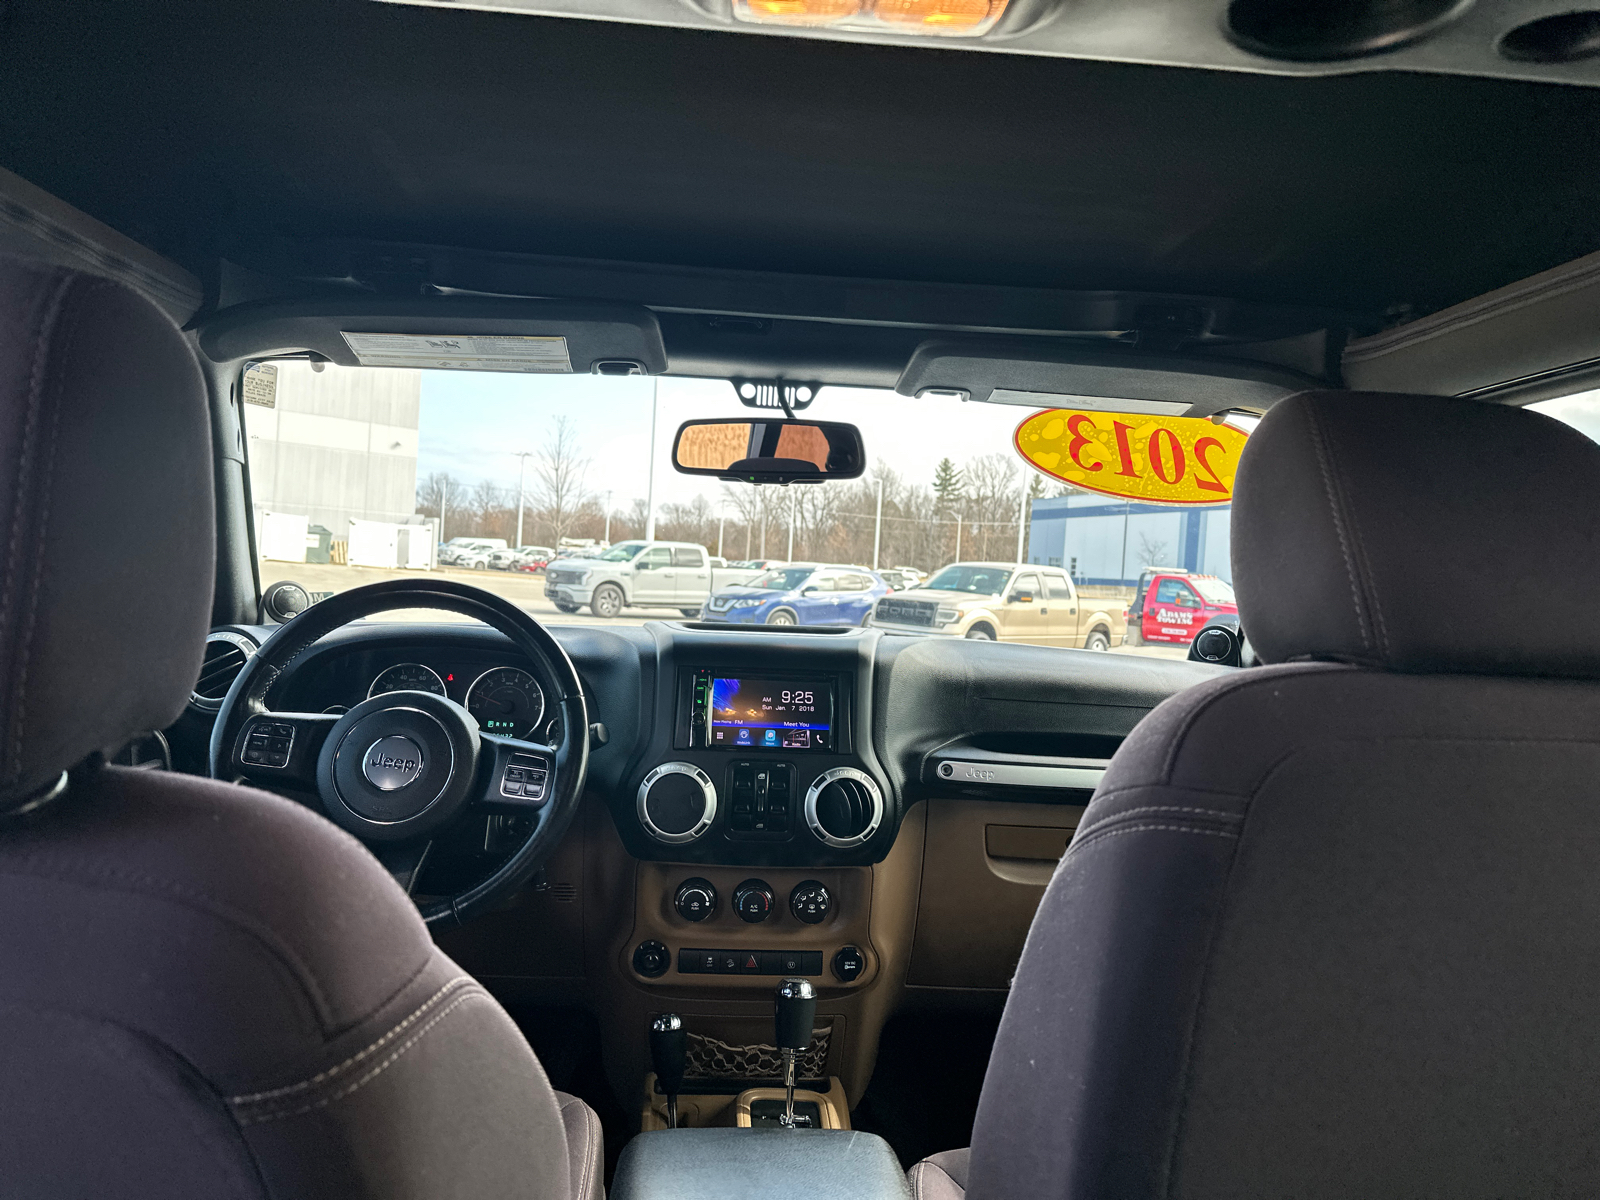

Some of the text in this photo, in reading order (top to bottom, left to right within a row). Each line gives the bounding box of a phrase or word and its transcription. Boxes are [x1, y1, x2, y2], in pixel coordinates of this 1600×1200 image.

[878, 605, 932, 617] FORD
[1157, 608, 1193, 619] ADAMS
[1158, 617, 1193, 625] TOWING
[781, 690, 814, 704] 9:25
[369, 753, 416, 773] Jeep
[965, 767, 995, 781] Jeep
